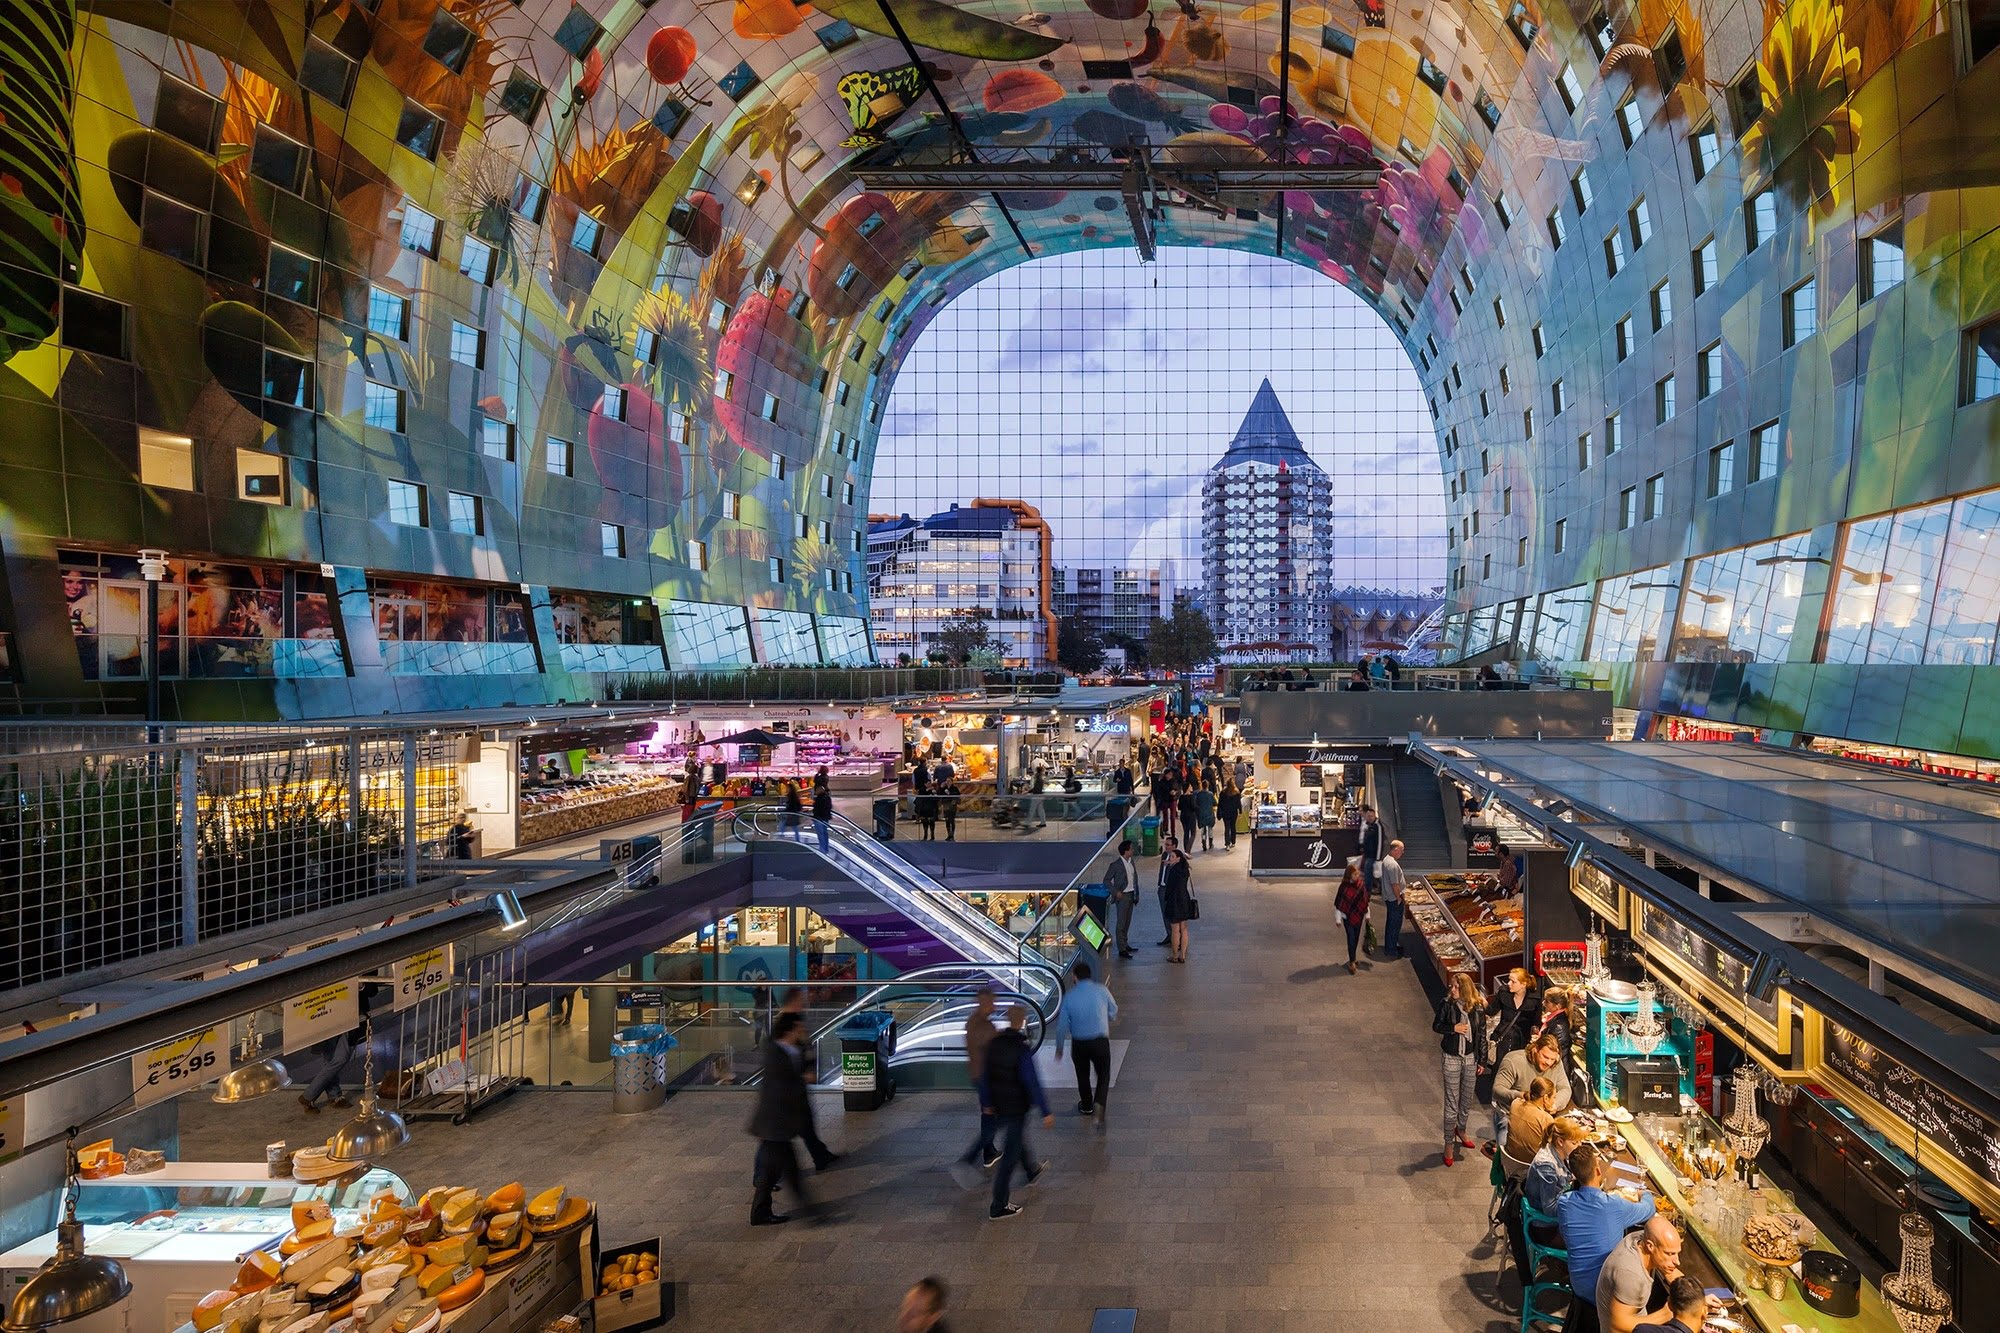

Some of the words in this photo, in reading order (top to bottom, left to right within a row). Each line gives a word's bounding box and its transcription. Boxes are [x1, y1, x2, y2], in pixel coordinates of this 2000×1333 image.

[388, 746, 444, 766] MRE
[1306, 747, 1358, 763] Délifrance
[611, 842, 632, 861] 48
[402, 984, 410, 994] €
[415, 971, 442, 991] 5,95
[310, 1011, 328, 1020] Gratis
[147, 1071, 159, 1085] €
[169, 1051, 216, 1080] 5,95
[148, 1060, 163, 1070] 500
[1643, 1091, 1662, 1099] Hertog
[1662, 1091, 1673, 1099] Jan
[1808, 1289, 1824, 1301] zero
